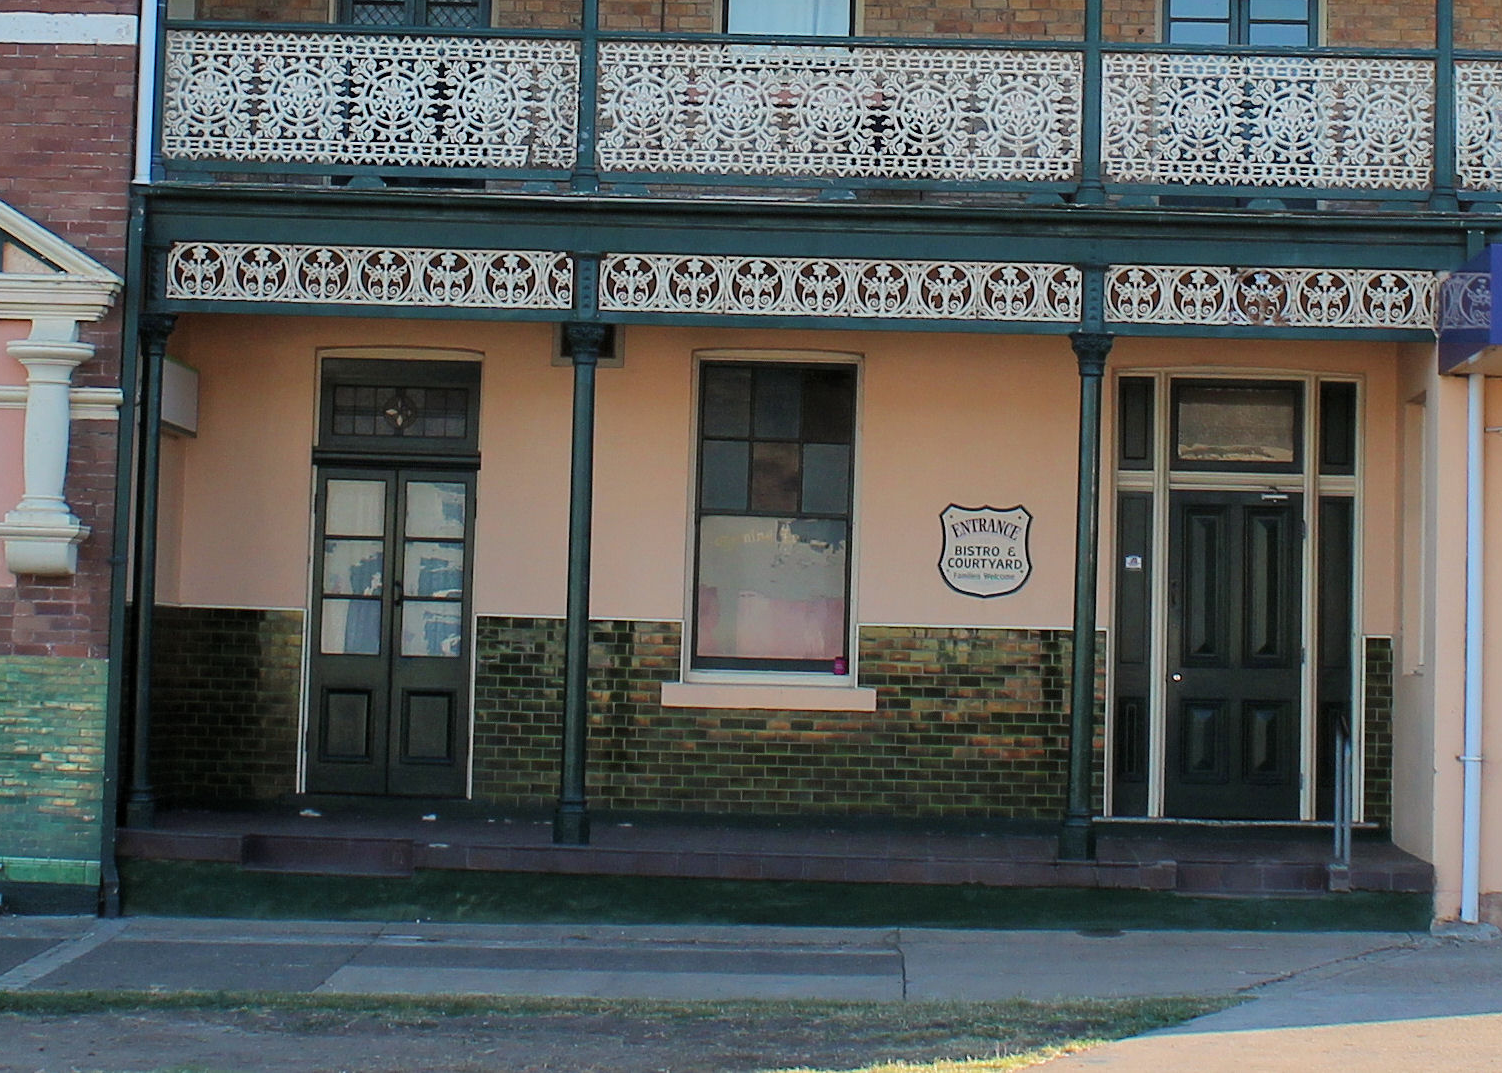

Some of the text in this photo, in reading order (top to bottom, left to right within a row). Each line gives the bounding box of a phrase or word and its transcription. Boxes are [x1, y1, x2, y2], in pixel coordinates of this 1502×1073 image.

[951, 517, 1022, 541] ENTRANCE
[954, 545, 1000, 557] BISTRO
[947, 558, 1023, 570] COURTYARD
